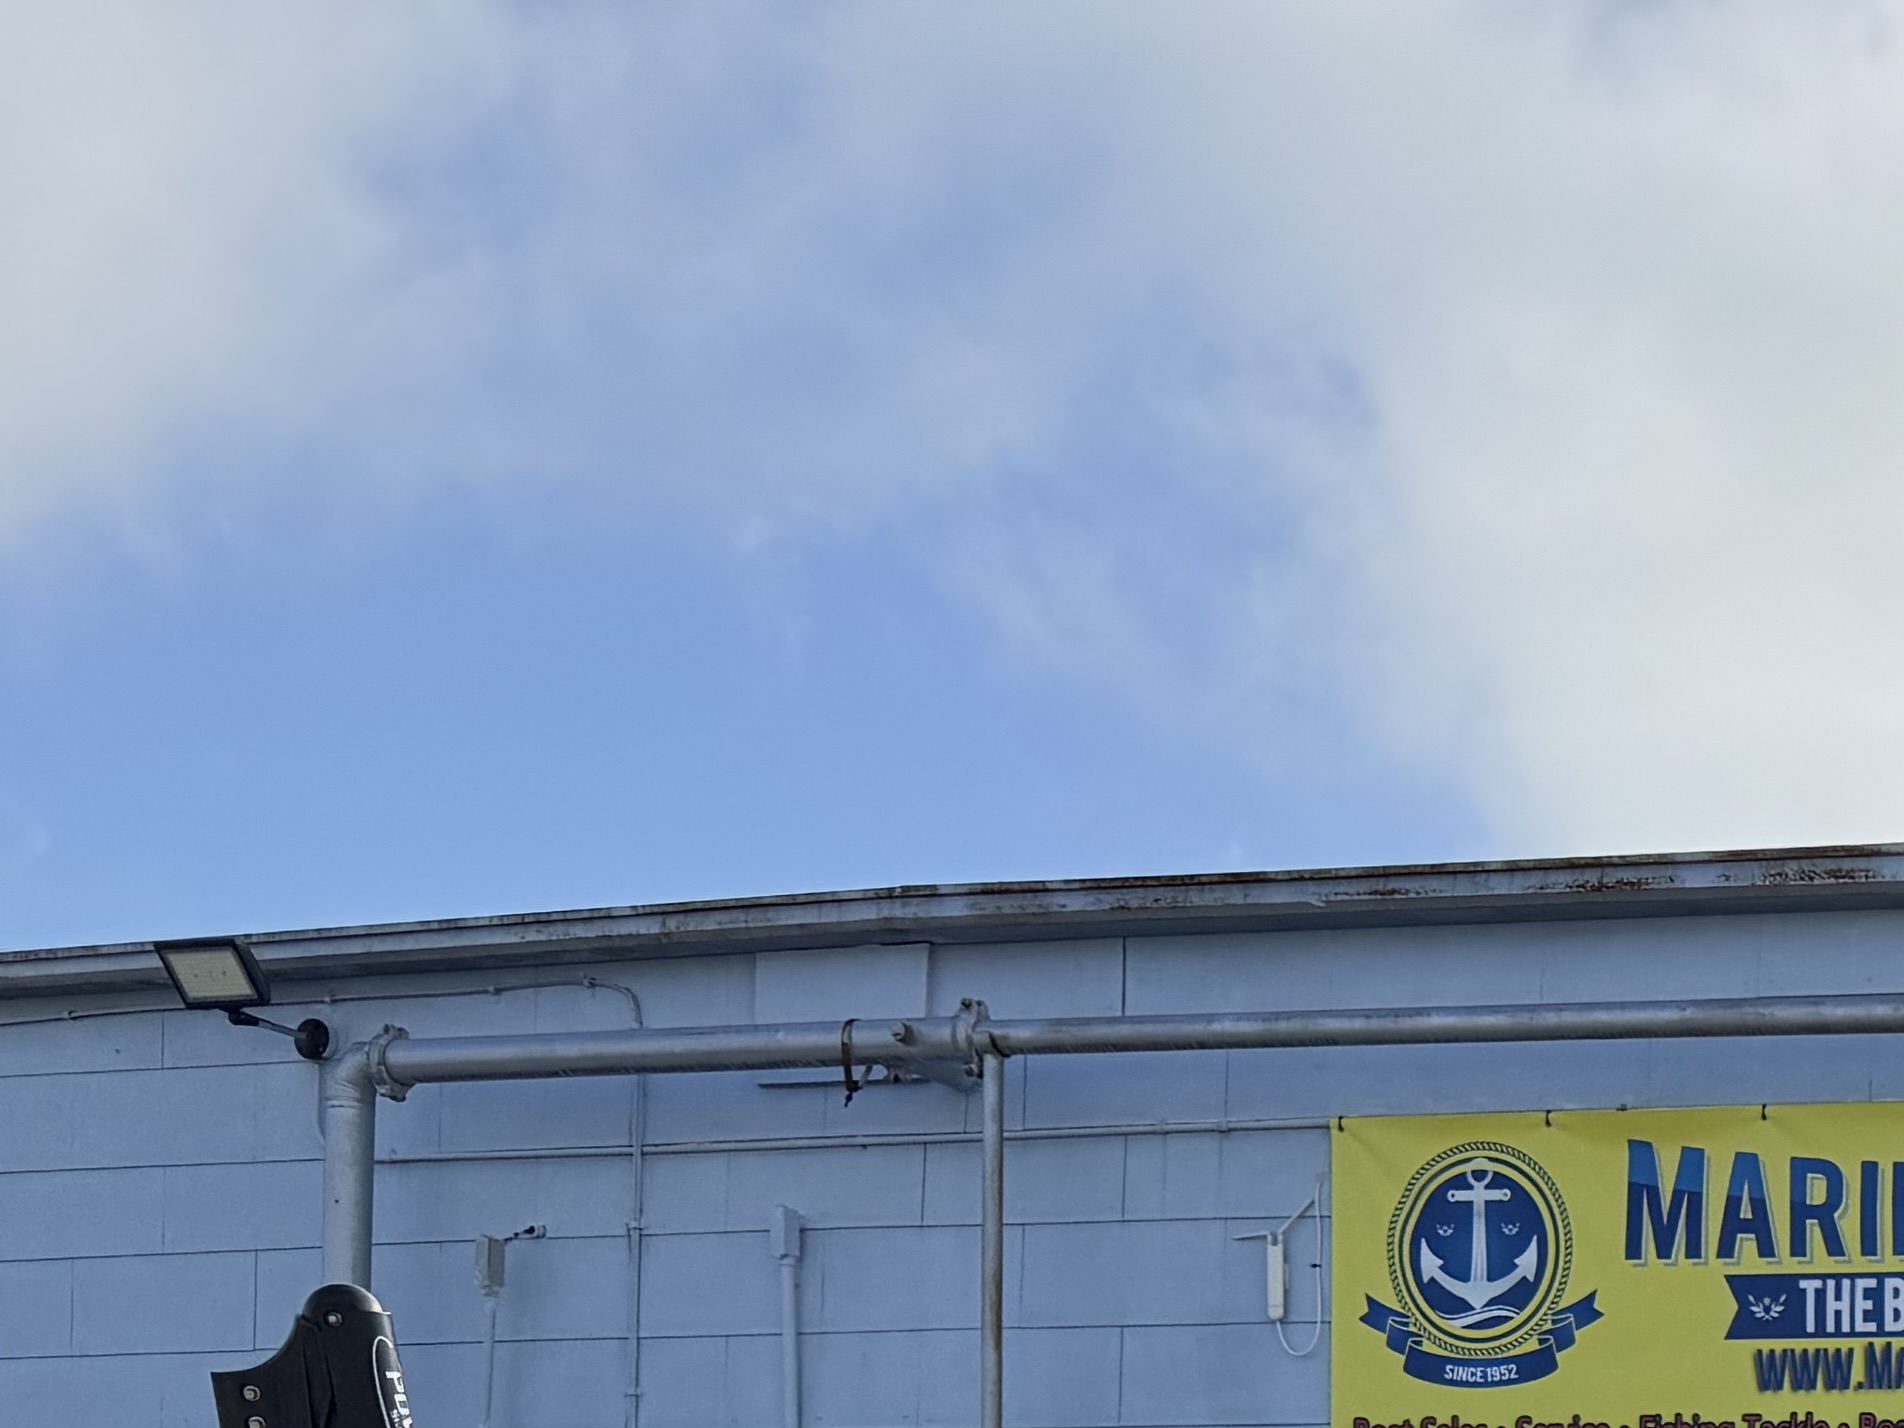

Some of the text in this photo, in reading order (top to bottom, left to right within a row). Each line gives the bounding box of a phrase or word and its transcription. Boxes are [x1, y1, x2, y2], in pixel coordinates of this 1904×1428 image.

[1799, 1278, 1877, 1334] THE
[1443, 1364, 1519, 1382] SINCE 1952
